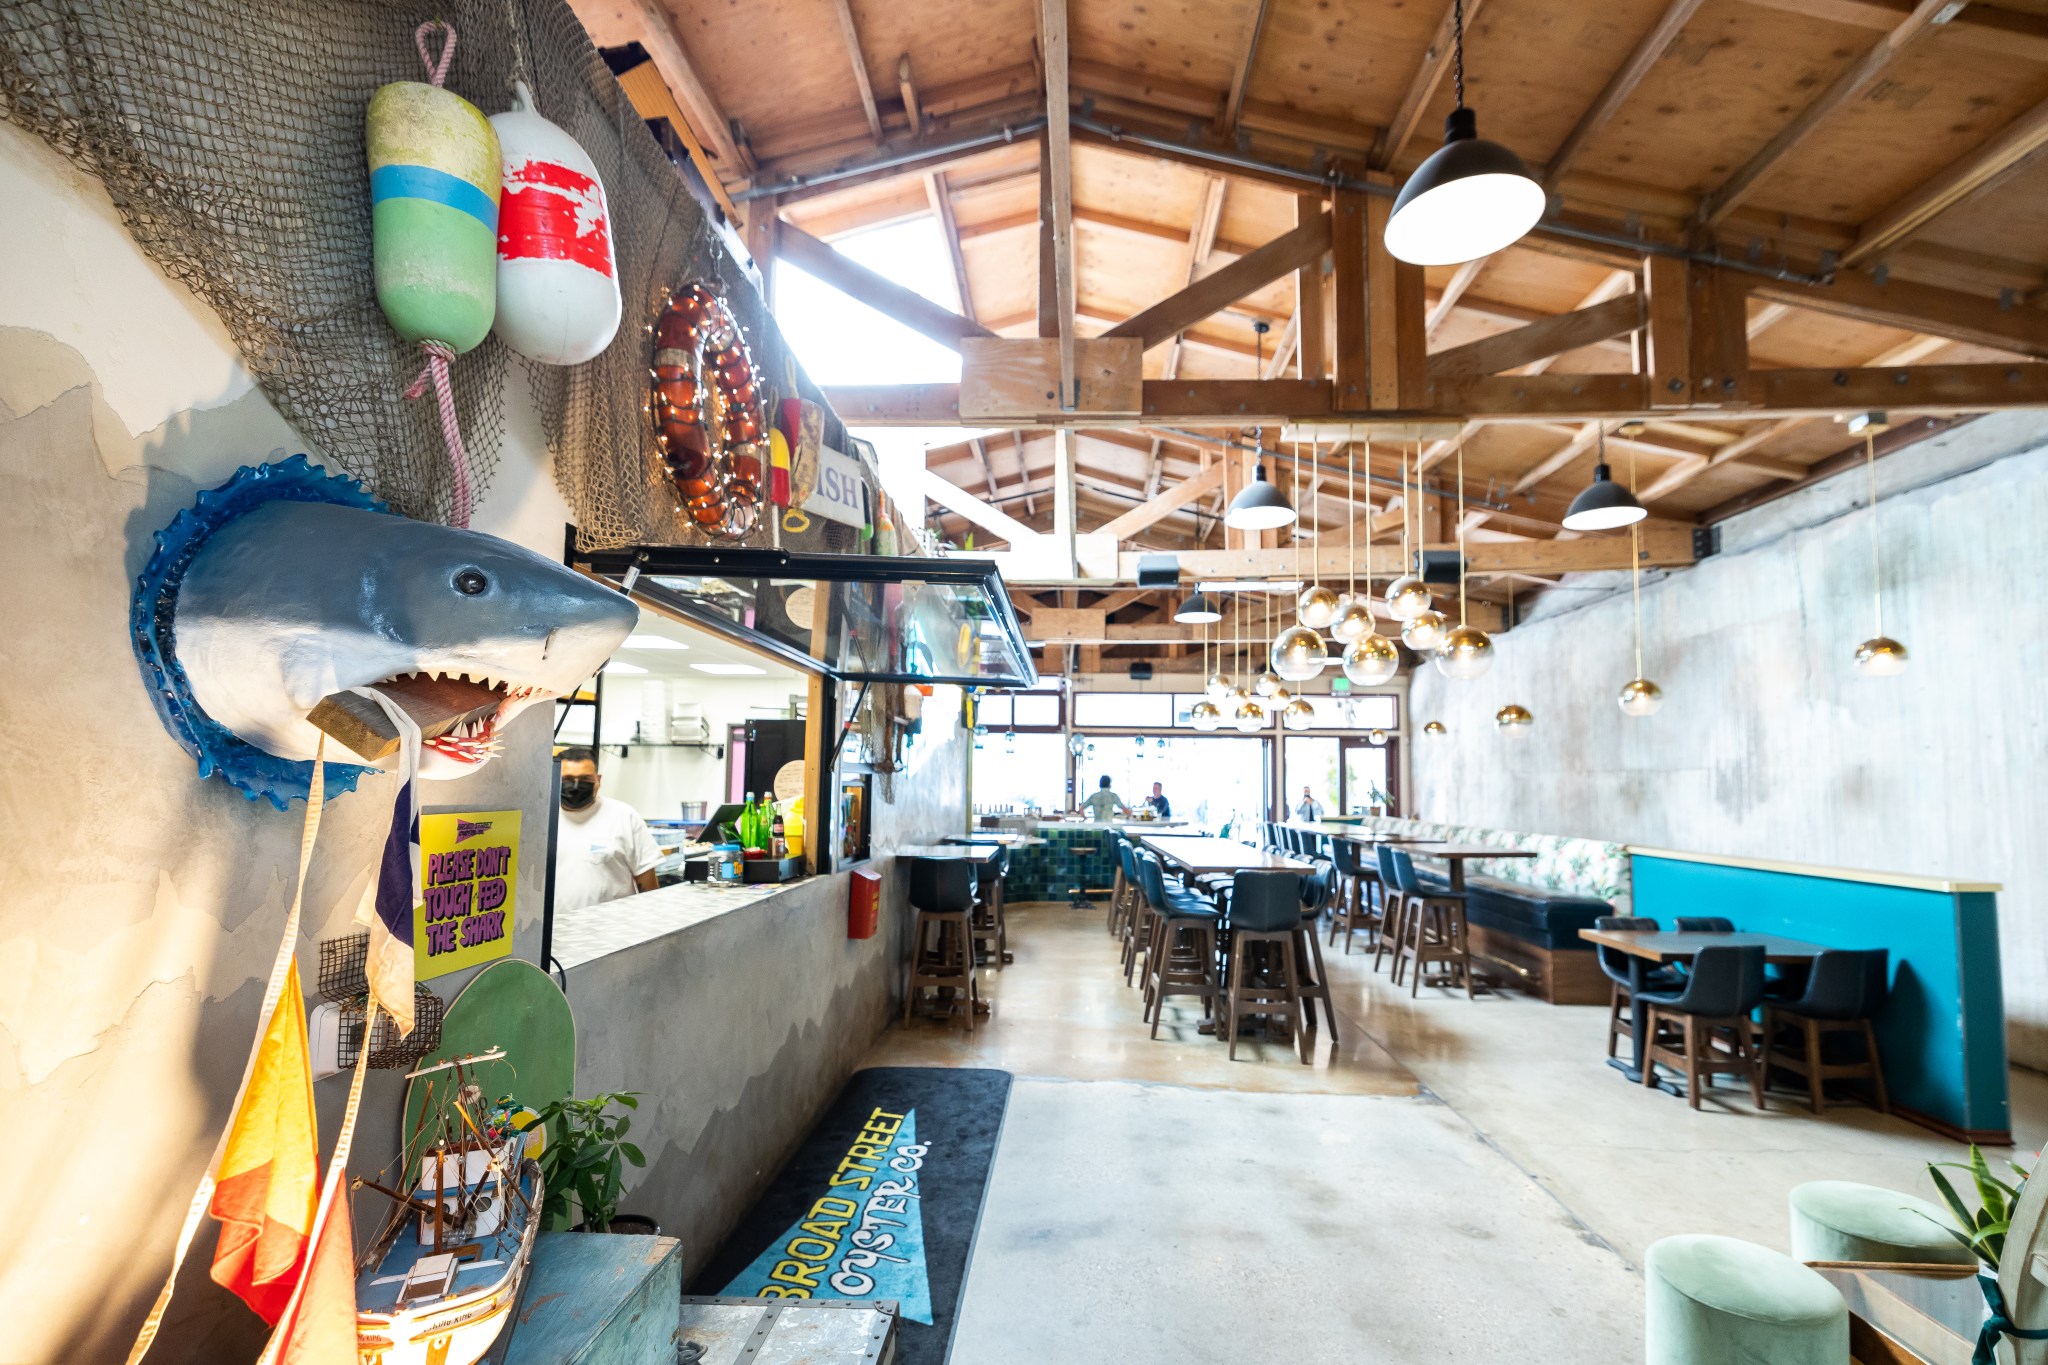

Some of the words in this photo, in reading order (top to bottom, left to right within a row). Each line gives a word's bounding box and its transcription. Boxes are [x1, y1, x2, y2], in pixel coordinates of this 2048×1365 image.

[428, 849, 475, 885] PLEASE
[476, 846, 511, 877] DON'T
[424, 882, 474, 921] TOUCH
[477, 878, 507, 912] FEED
[426, 920, 458, 957] THE
[459, 910, 505, 948] SHARK
[828, 1107, 905, 1191] STREET
[829, 1176, 922, 1296] OYSTER
